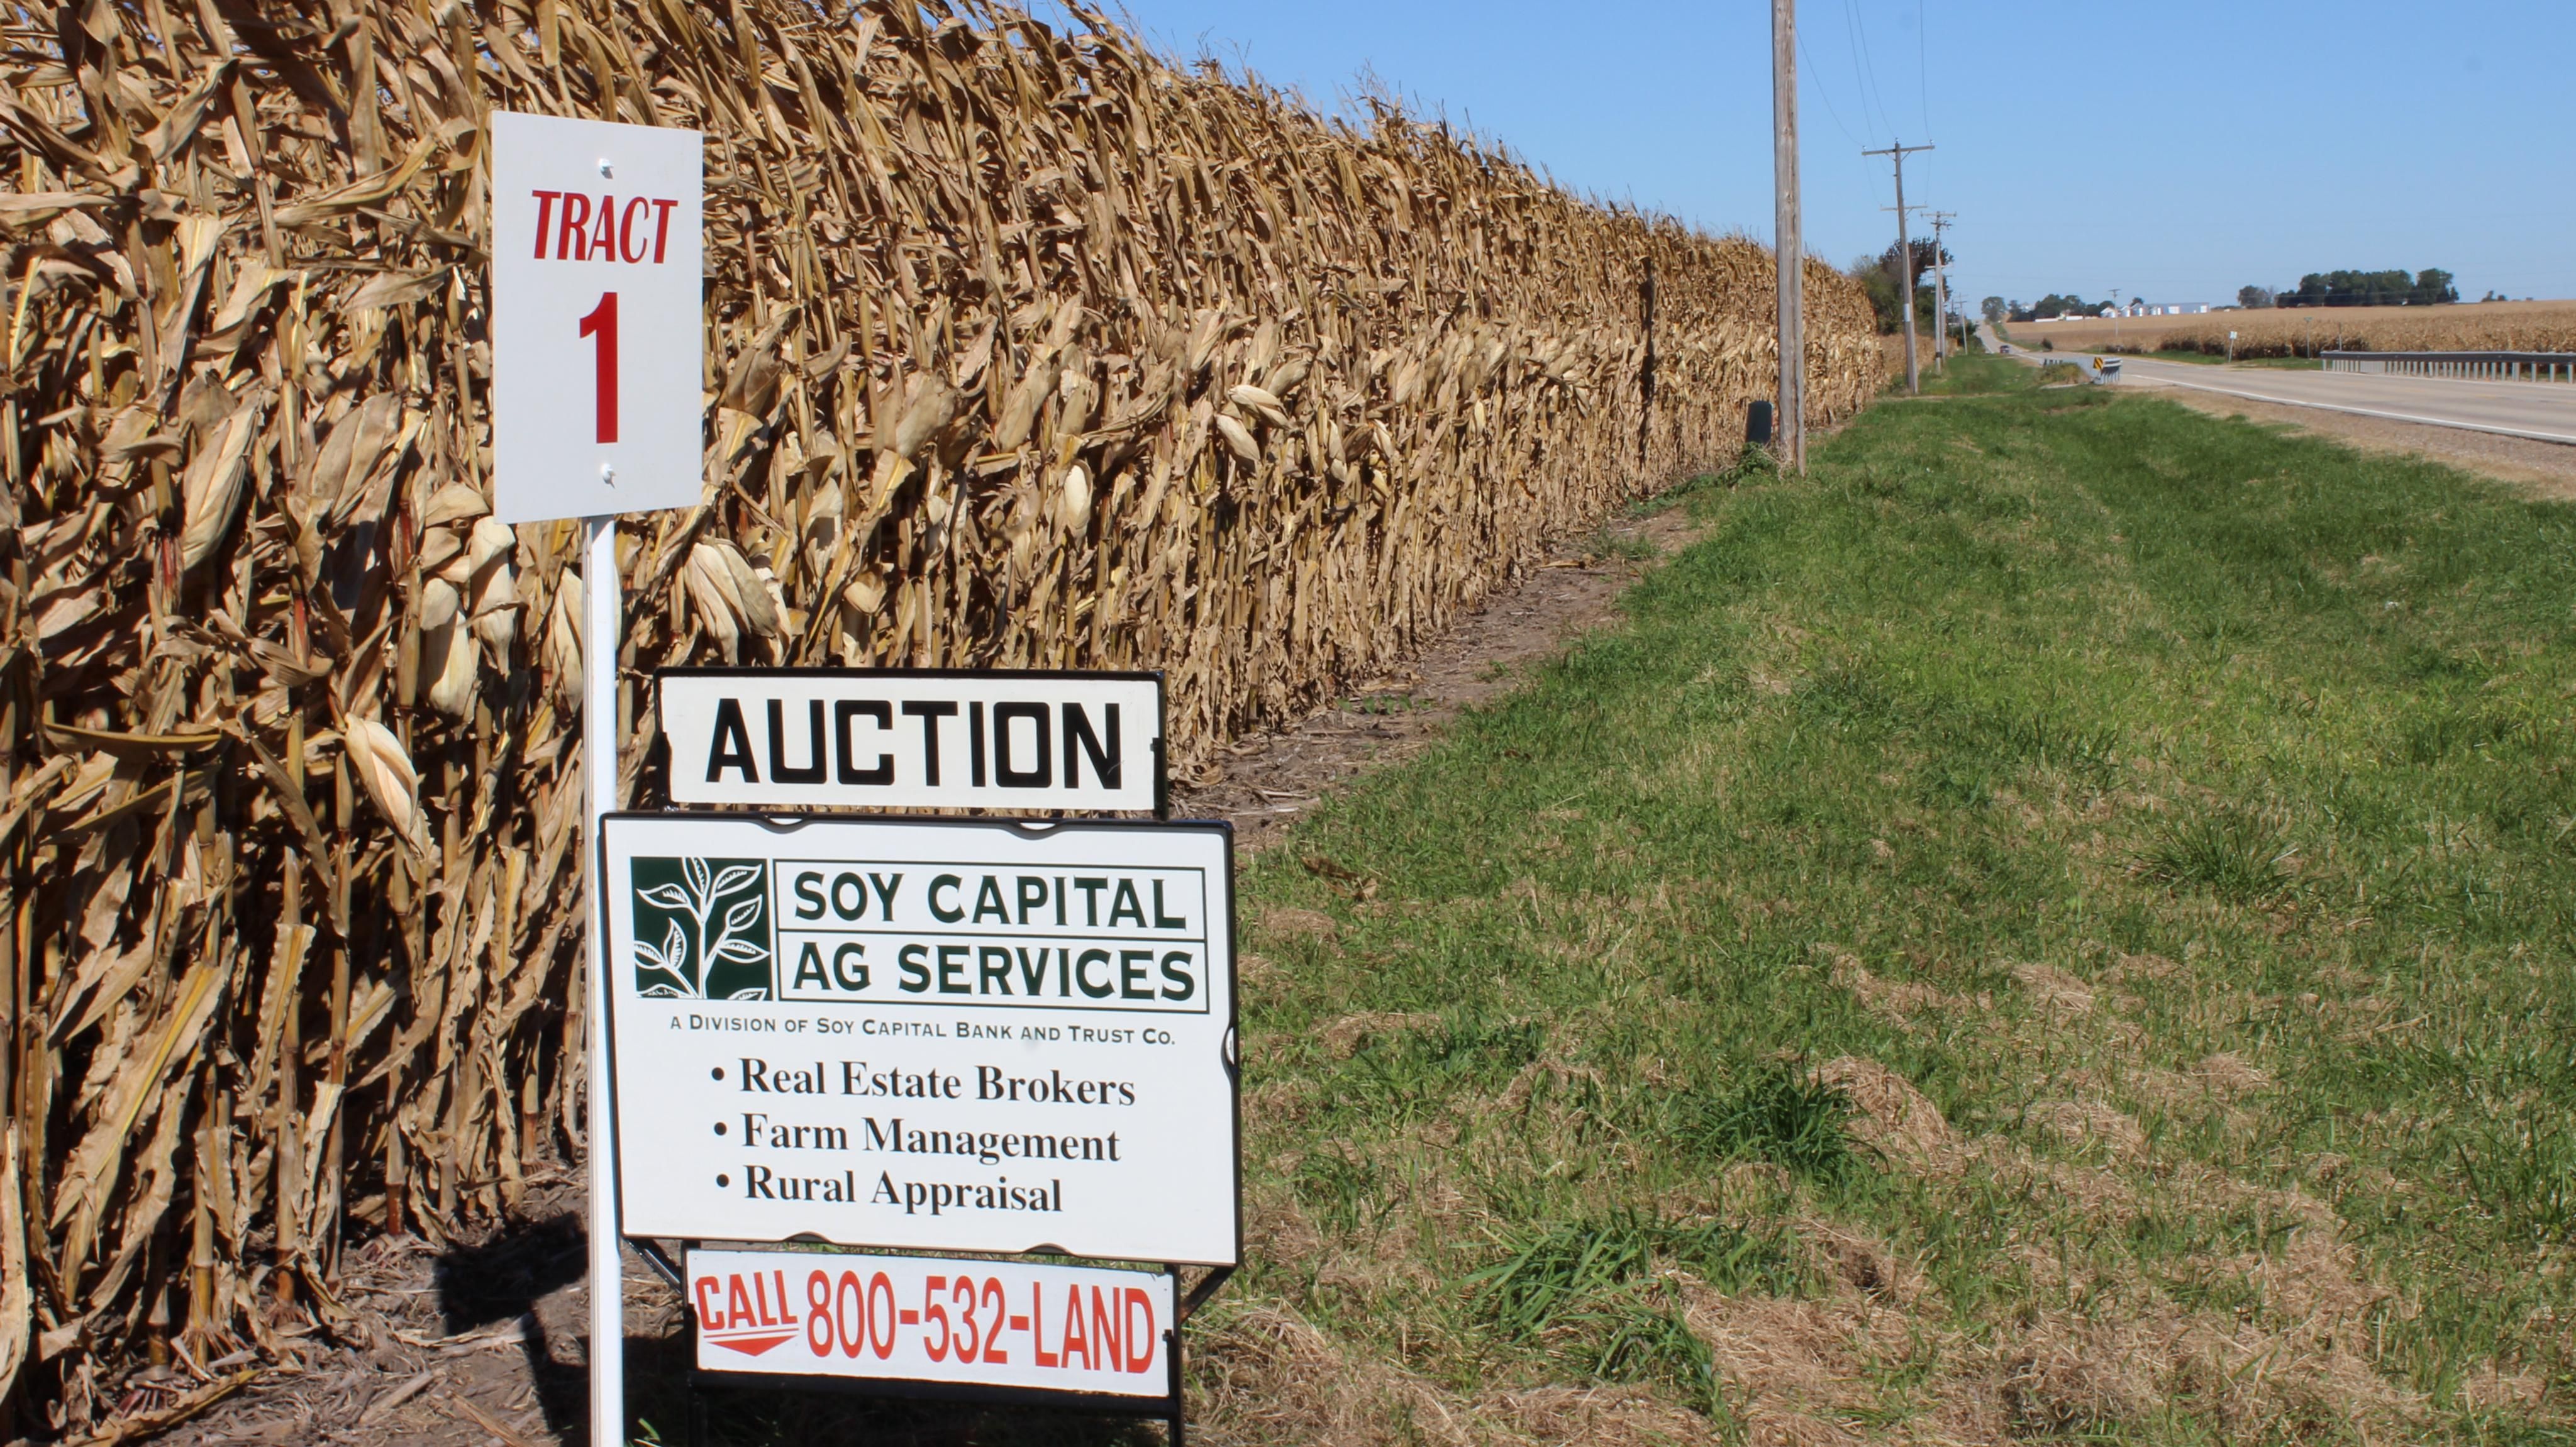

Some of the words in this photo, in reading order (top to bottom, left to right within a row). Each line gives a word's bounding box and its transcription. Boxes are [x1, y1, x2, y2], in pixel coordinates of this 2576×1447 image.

[532, 190, 679, 264] TRACT
[579, 292, 618, 443] 1
[705, 698, 1122, 790] AUCTION
[794, 871, 904, 922] SOY
[928, 873, 1186, 929] CAPITAL
[792, 941, 871, 992] AG
[898, 943, 1195, 1002] SERVICES
[689, 1014, 775, 1032] DIVISION
[784, 1019, 808, 1033] OF
[817, 1017, 854, 1034] SOY
[862, 1019, 947, 1038] CAPITAL
[956, 1021, 1012, 1040] BANK
[1021, 1026, 1060, 1041] AND
[1067, 1025, 1135, 1043] TRUST
[1142, 1028, 1175, 1045] CO.
[740, 1058, 826, 1094] Real
[841, 1061, 961, 1099] Estate
[977, 1065, 1135, 1106] Brokers
[743, 1113, 848, 1150] Farm
[863, 1117, 1119, 1165] Management
[745, 1165, 855, 1202] Rural
[871, 1170, 1062, 1216] Appraisal
[695, 1270, 797, 1331] CALL
[807, 1269, 1155, 1374] 800-532-LAND
